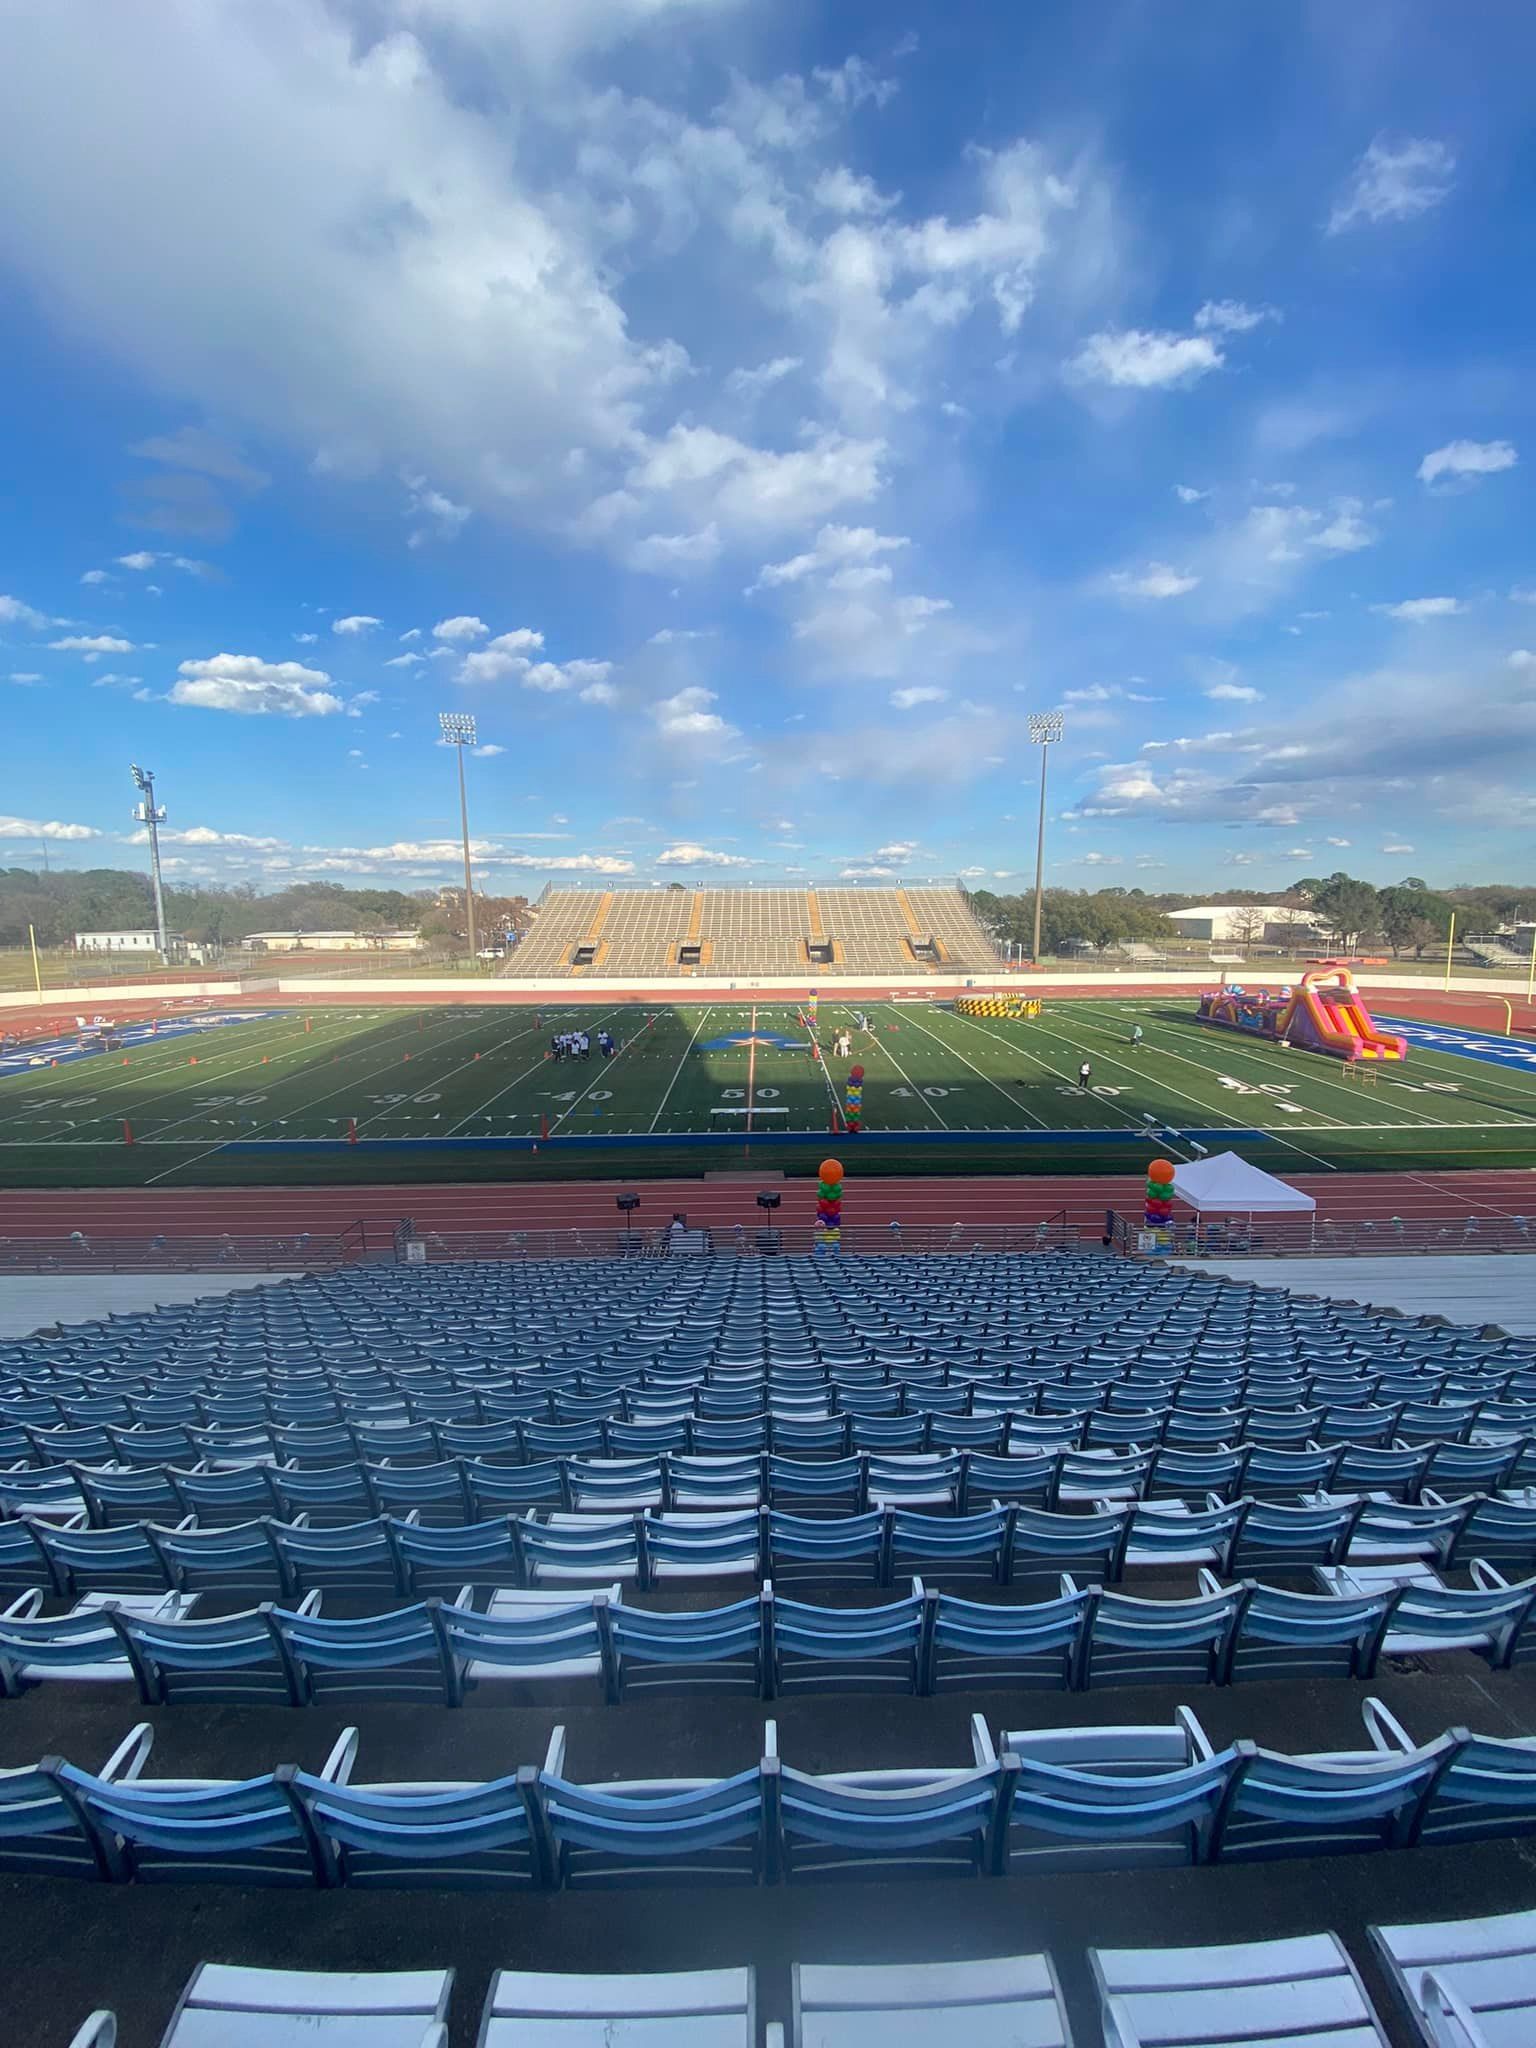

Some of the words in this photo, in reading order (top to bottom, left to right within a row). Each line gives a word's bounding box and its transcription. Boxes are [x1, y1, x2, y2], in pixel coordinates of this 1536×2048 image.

[551, 1090, 613, 1101] 40
[721, 1088, 780, 1098] 50
[889, 1086, 949, 1097] 40
[1054, 1085, 1120, 1096] 30
